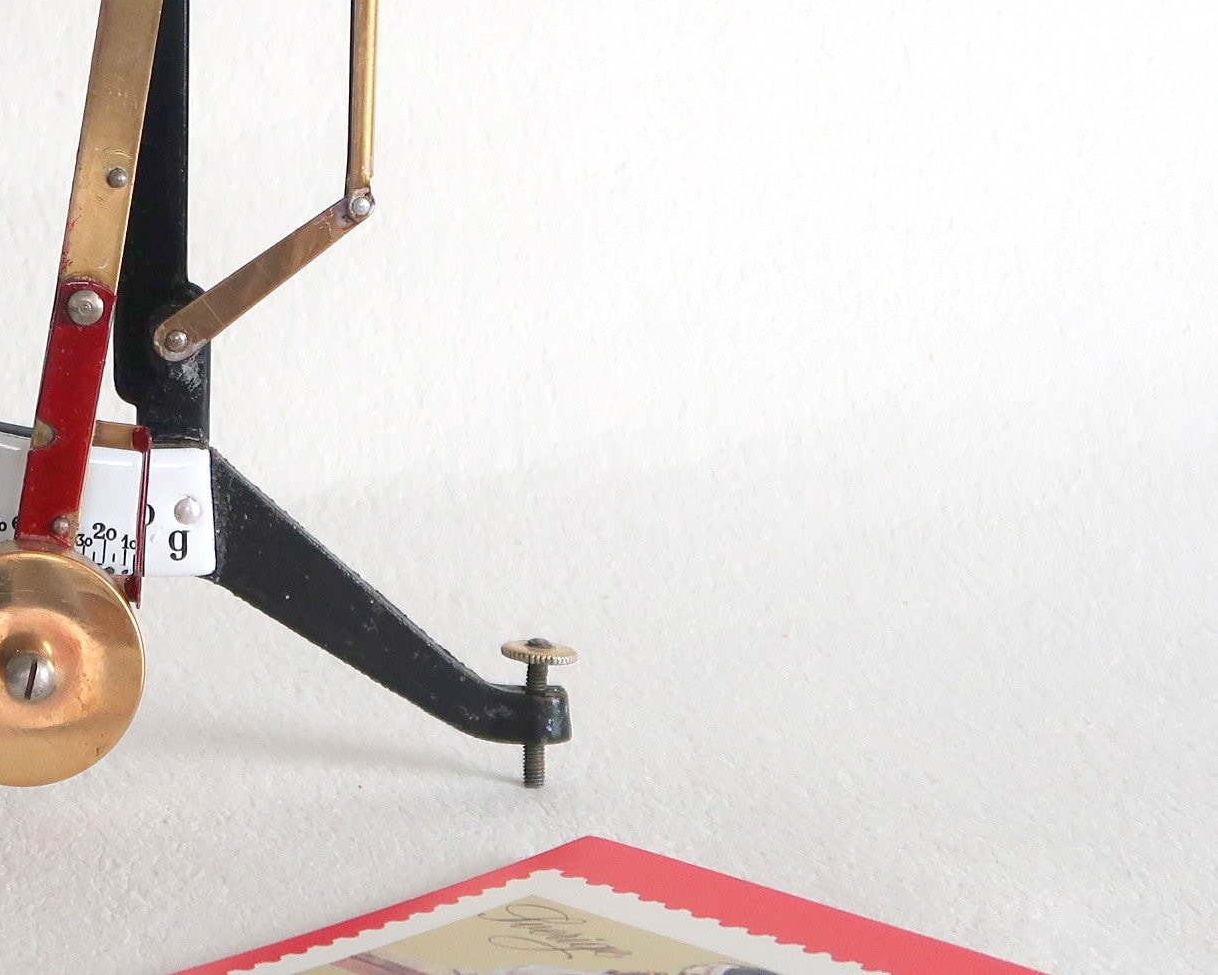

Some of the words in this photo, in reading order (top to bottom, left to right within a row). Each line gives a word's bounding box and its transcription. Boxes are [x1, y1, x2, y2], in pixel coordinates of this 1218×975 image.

[75, 533, 93, 547] 30
[92, 522, 117, 541] 20
[168, 529, 191, 561] g
